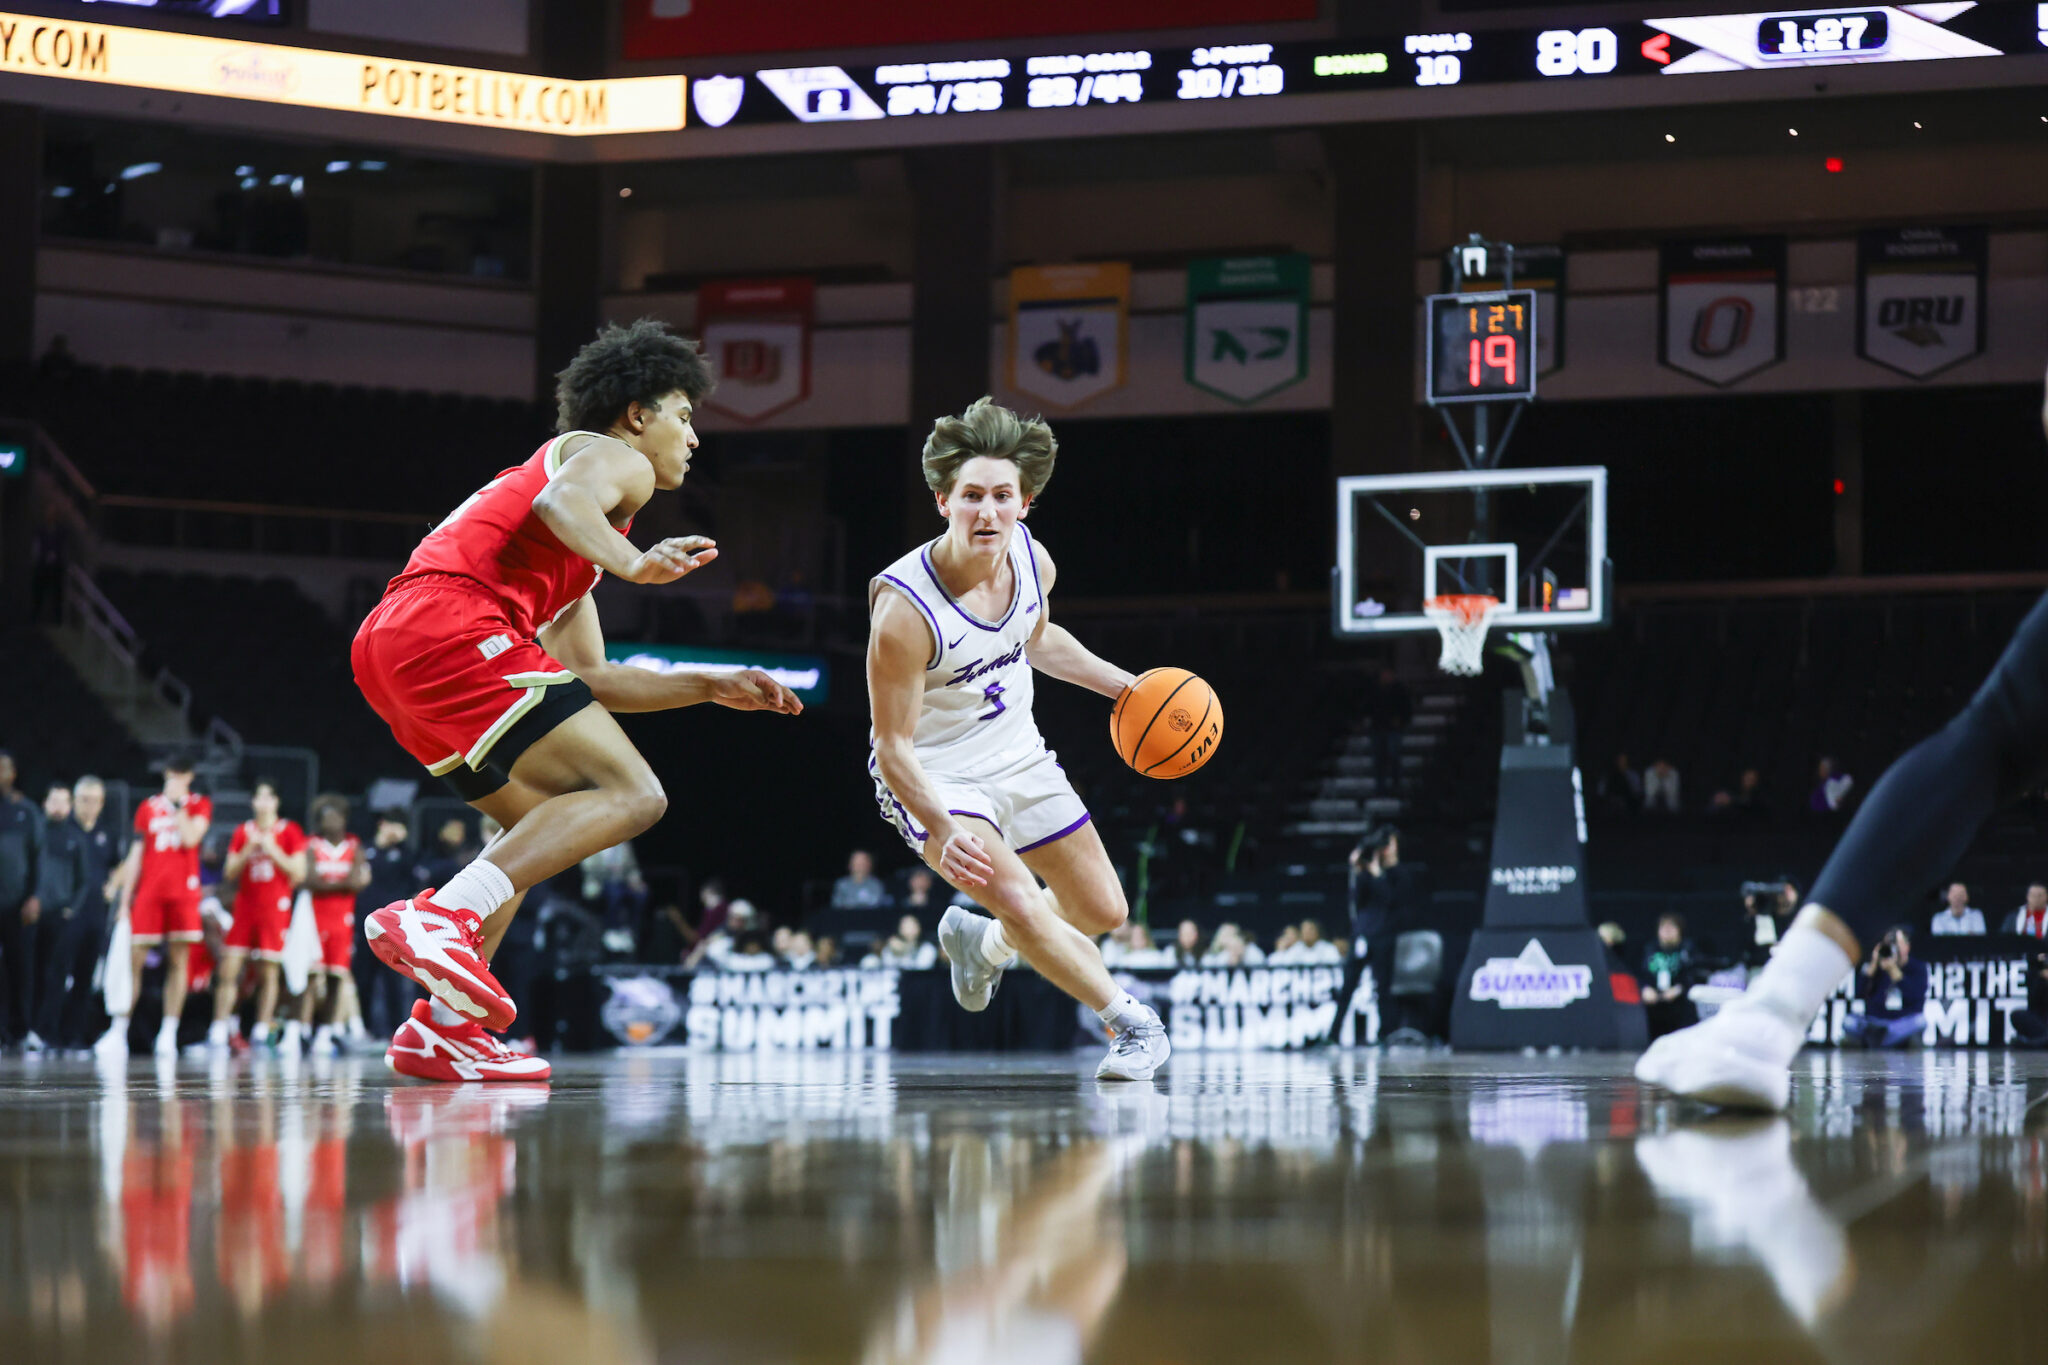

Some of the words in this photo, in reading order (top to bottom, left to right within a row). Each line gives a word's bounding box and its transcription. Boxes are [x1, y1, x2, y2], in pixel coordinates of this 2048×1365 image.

[1536, 28, 1618, 76] 80
[1778, 17, 1868, 53] 1:27
[1416, 55, 1460, 86] 10
[363, 65, 607, 126] POTBELLY.COM
[1878, 294, 1966, 328] ORU
[1469, 335, 1516, 387] 19
[1479, 973, 1583, 993] SUMMIT
[686, 1003, 899, 1050] SUMMIT
